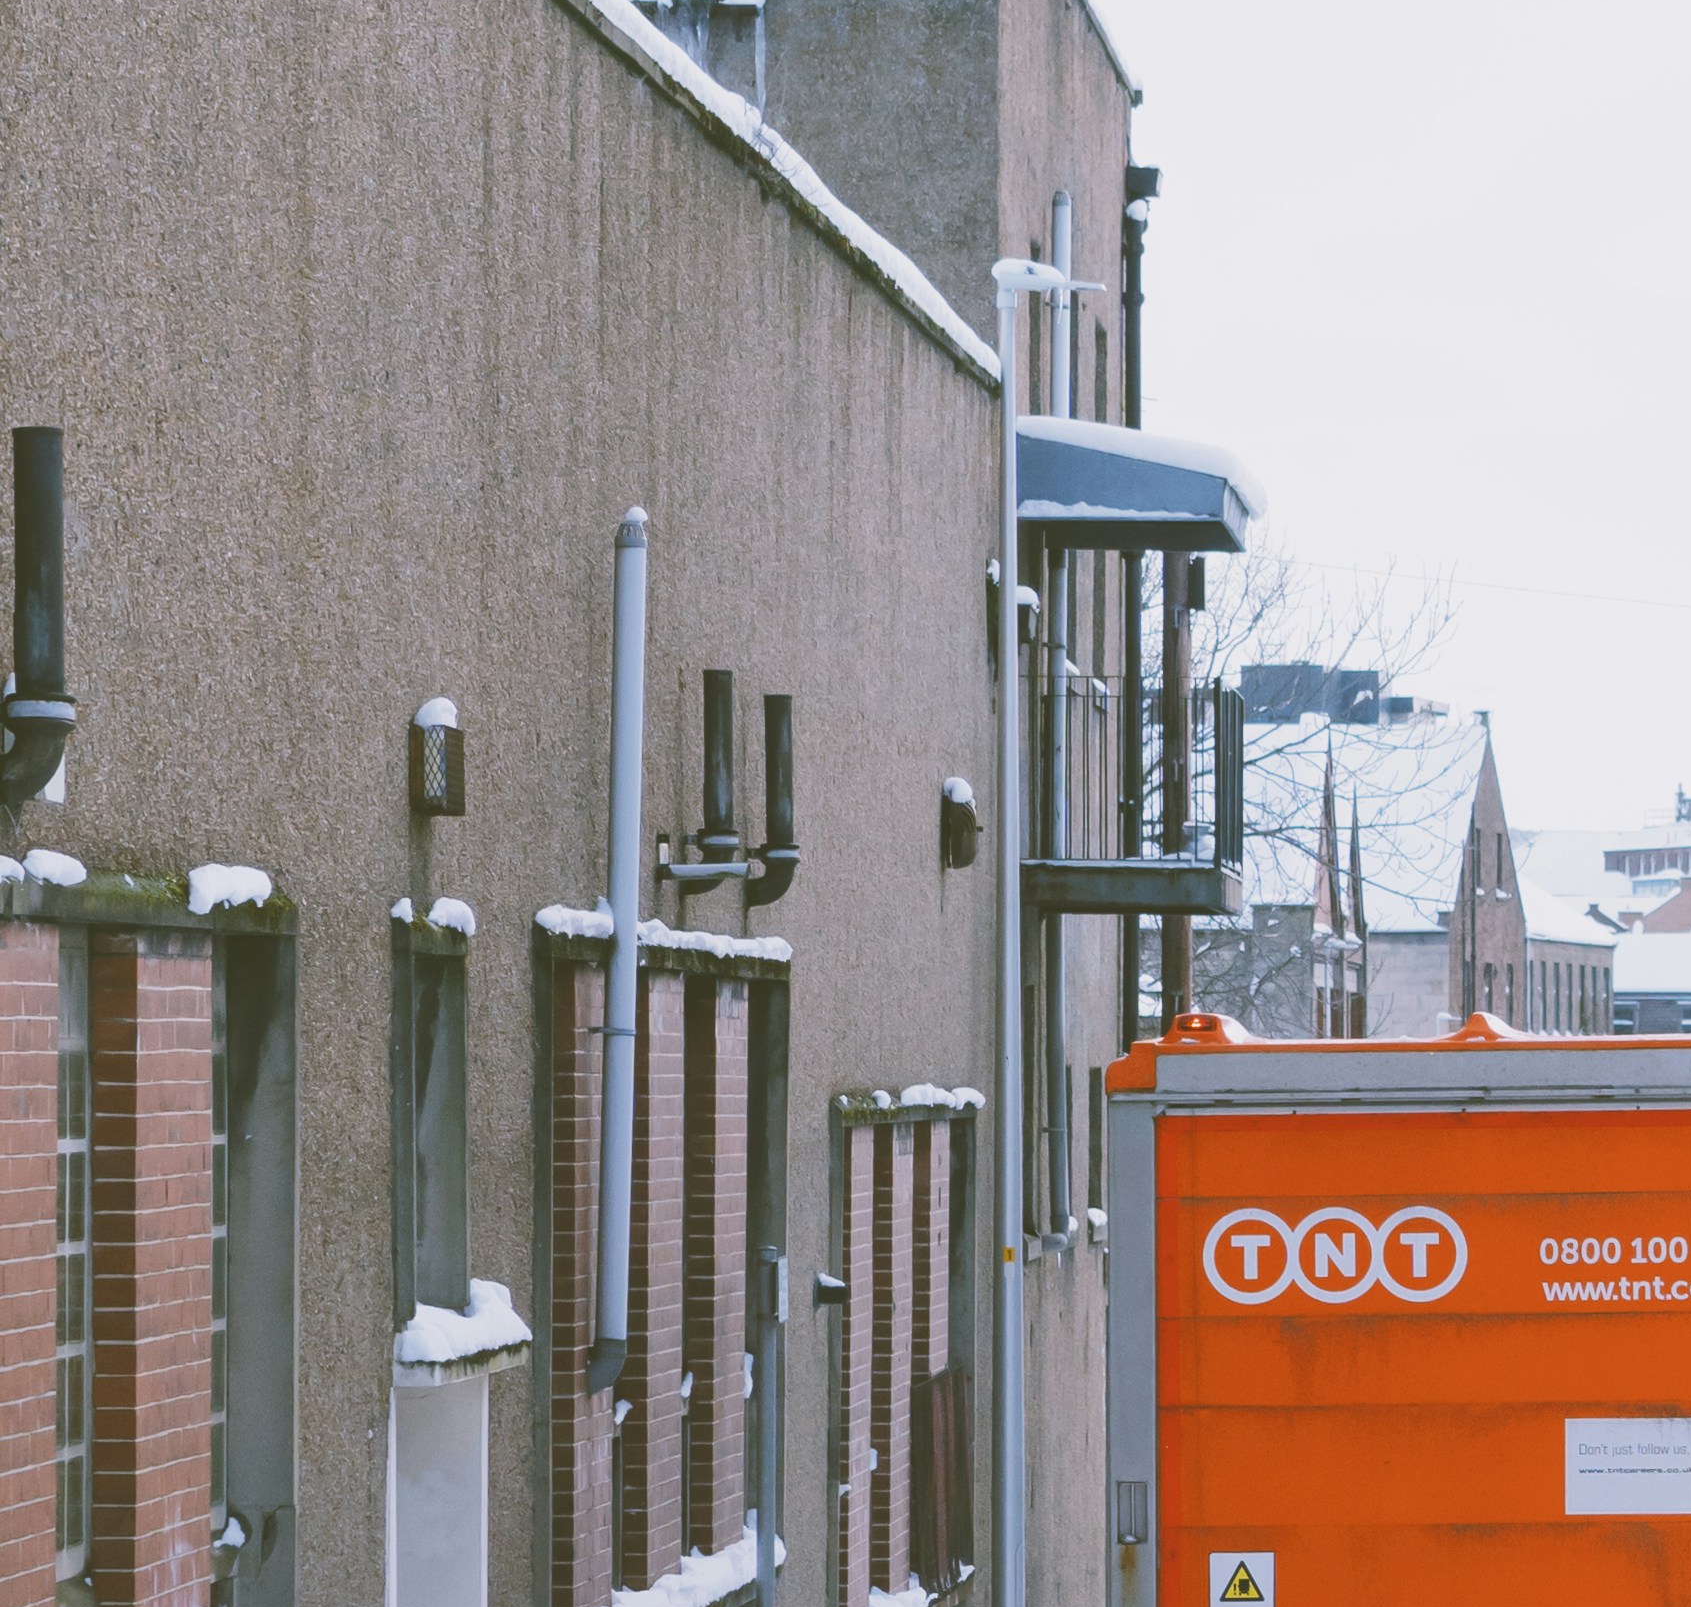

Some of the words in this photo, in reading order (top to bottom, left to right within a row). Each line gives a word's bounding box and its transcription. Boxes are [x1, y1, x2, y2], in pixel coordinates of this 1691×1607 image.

[1539, 1237, 1622, 1265] 0800
[1630, 1236, 1688, 1264] 100
[1578, 1444, 1607, 1456] Don't
[1612, 1444, 1633, 1457] just
[1637, 1444, 1669, 1455] follow
